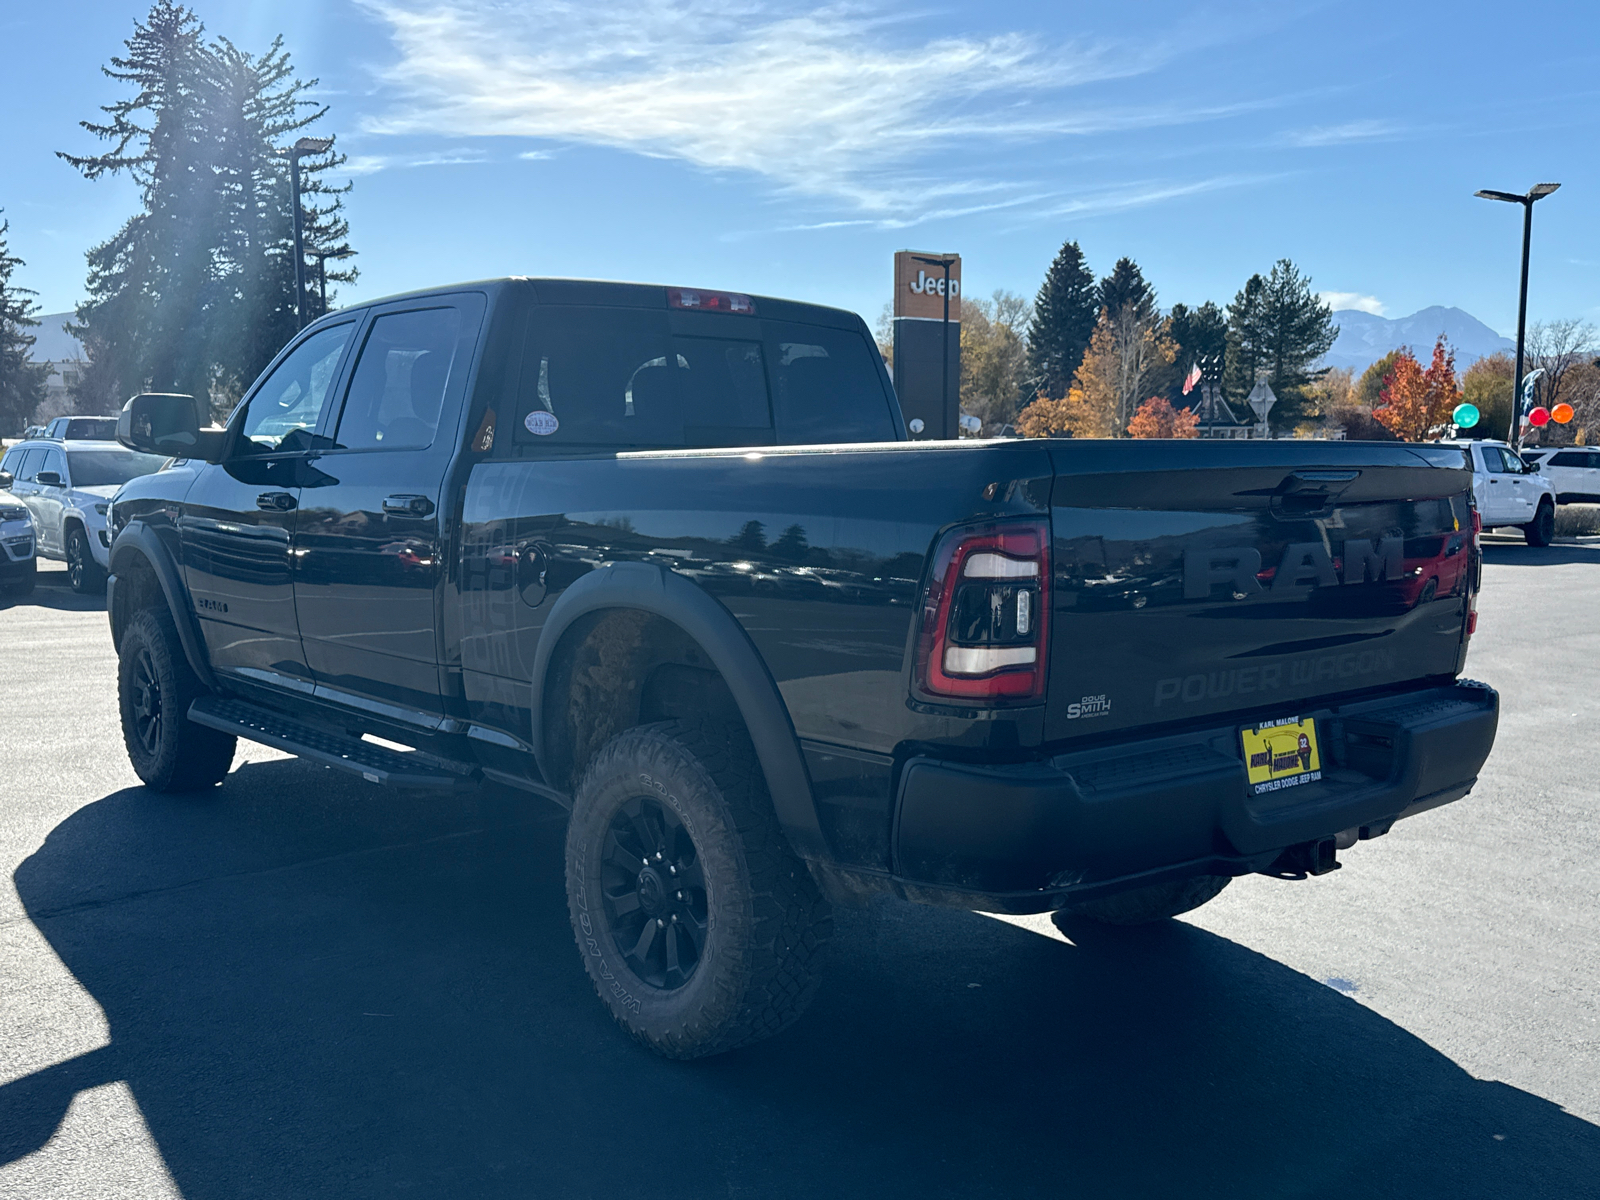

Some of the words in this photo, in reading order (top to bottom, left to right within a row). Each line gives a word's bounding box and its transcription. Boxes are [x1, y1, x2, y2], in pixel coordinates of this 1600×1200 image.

[909, 270, 959, 301] Jeep
[1183, 536, 1404, 599] RAM
[1153, 663, 1282, 707] POWER
[1290, 647, 1396, 686] WAGON
[1082, 694, 1106, 702] DOUG
[1066, 699, 1111, 719] SMITH
[1276, 716, 1299, 727] MALONE
[1300, 738, 1308, 748] 32
[1250, 752, 1268, 769] KARL
[1273, 754, 1300, 773] MALONE
[1255, 782, 1281, 794] CHRYSLER
[1281, 778, 1298, 788] DODGE
[1299, 775, 1311, 784] JEEP
[1311, 771, 1321, 781] RAM
[573, 838, 643, 1015] WRANGLER
